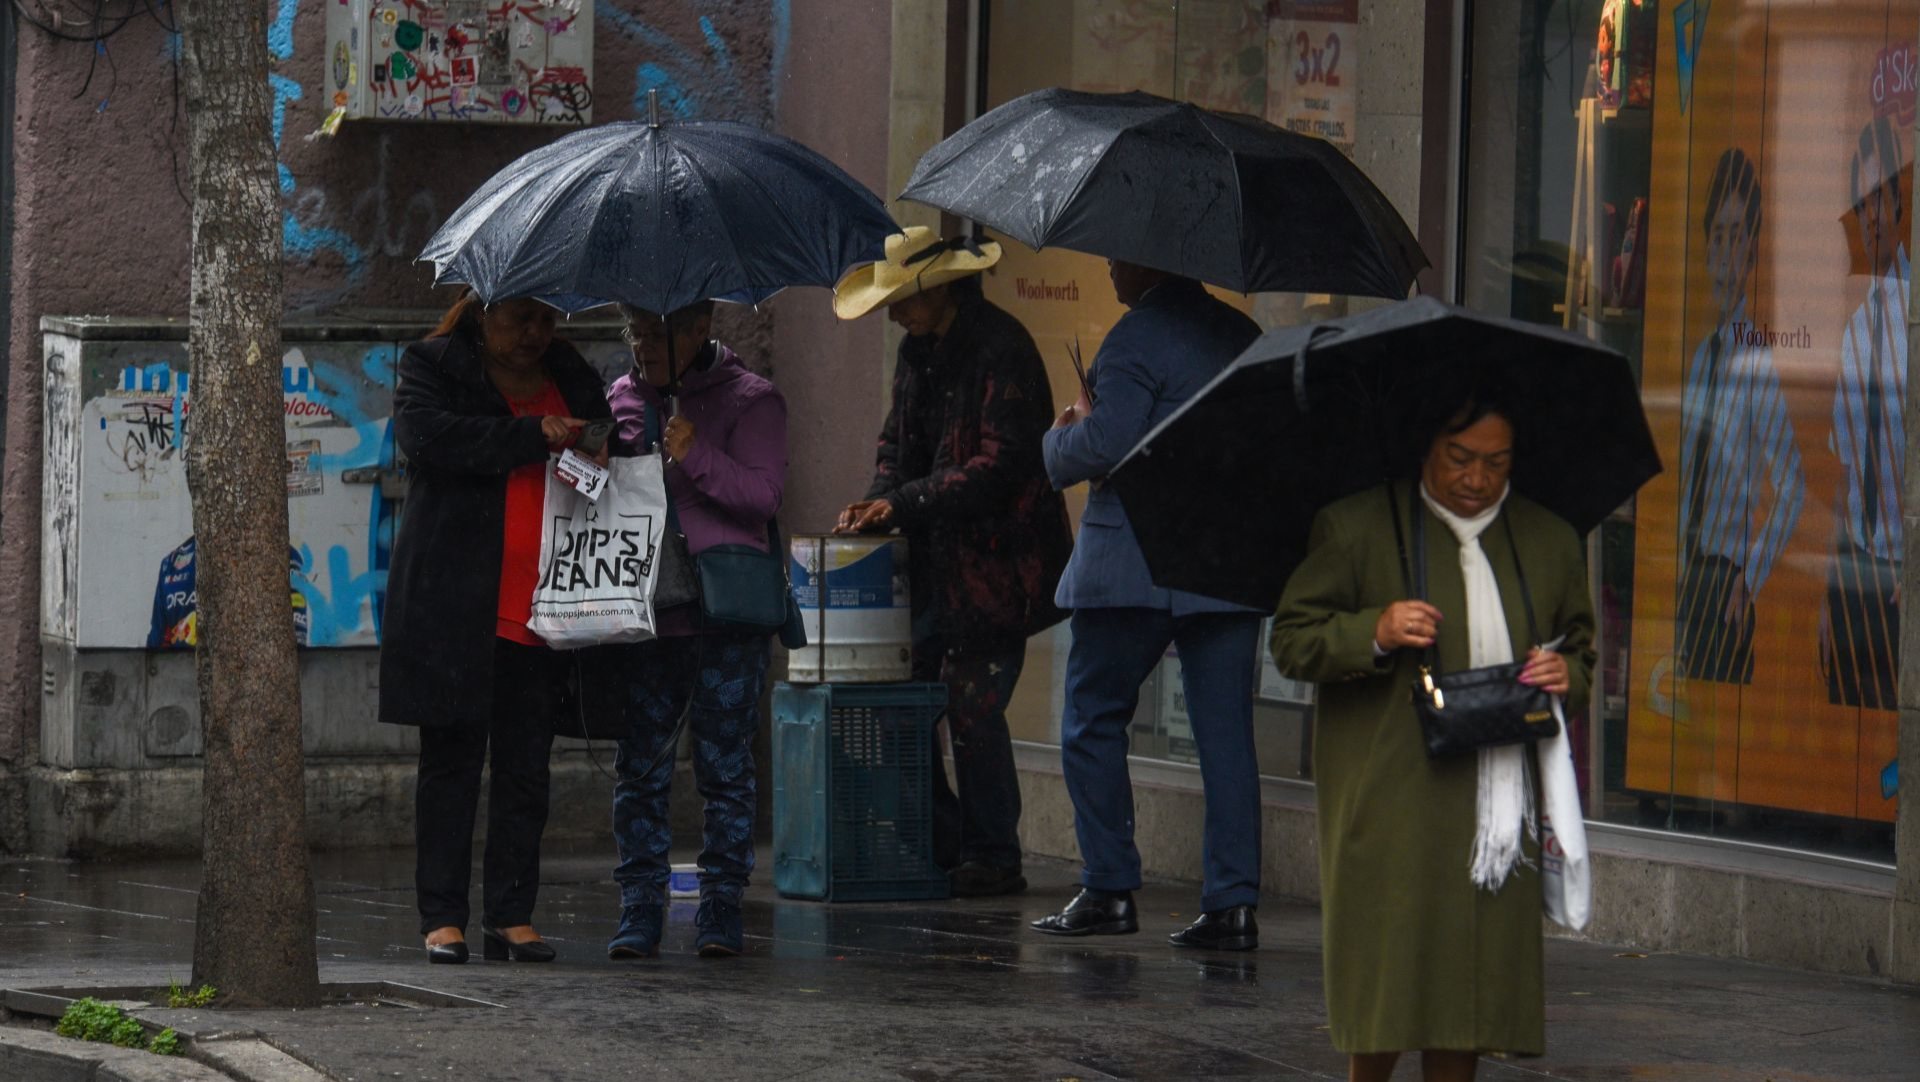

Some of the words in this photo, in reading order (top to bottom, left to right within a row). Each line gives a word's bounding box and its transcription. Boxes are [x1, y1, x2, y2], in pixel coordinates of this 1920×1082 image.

[1295, 30, 1341, 87] 3x2
[1016, 277, 1079, 301] Woolworth
[1732, 322, 1811, 349] Woolworth
[536, 608, 634, 619] www.oppsjeans.com.mx
